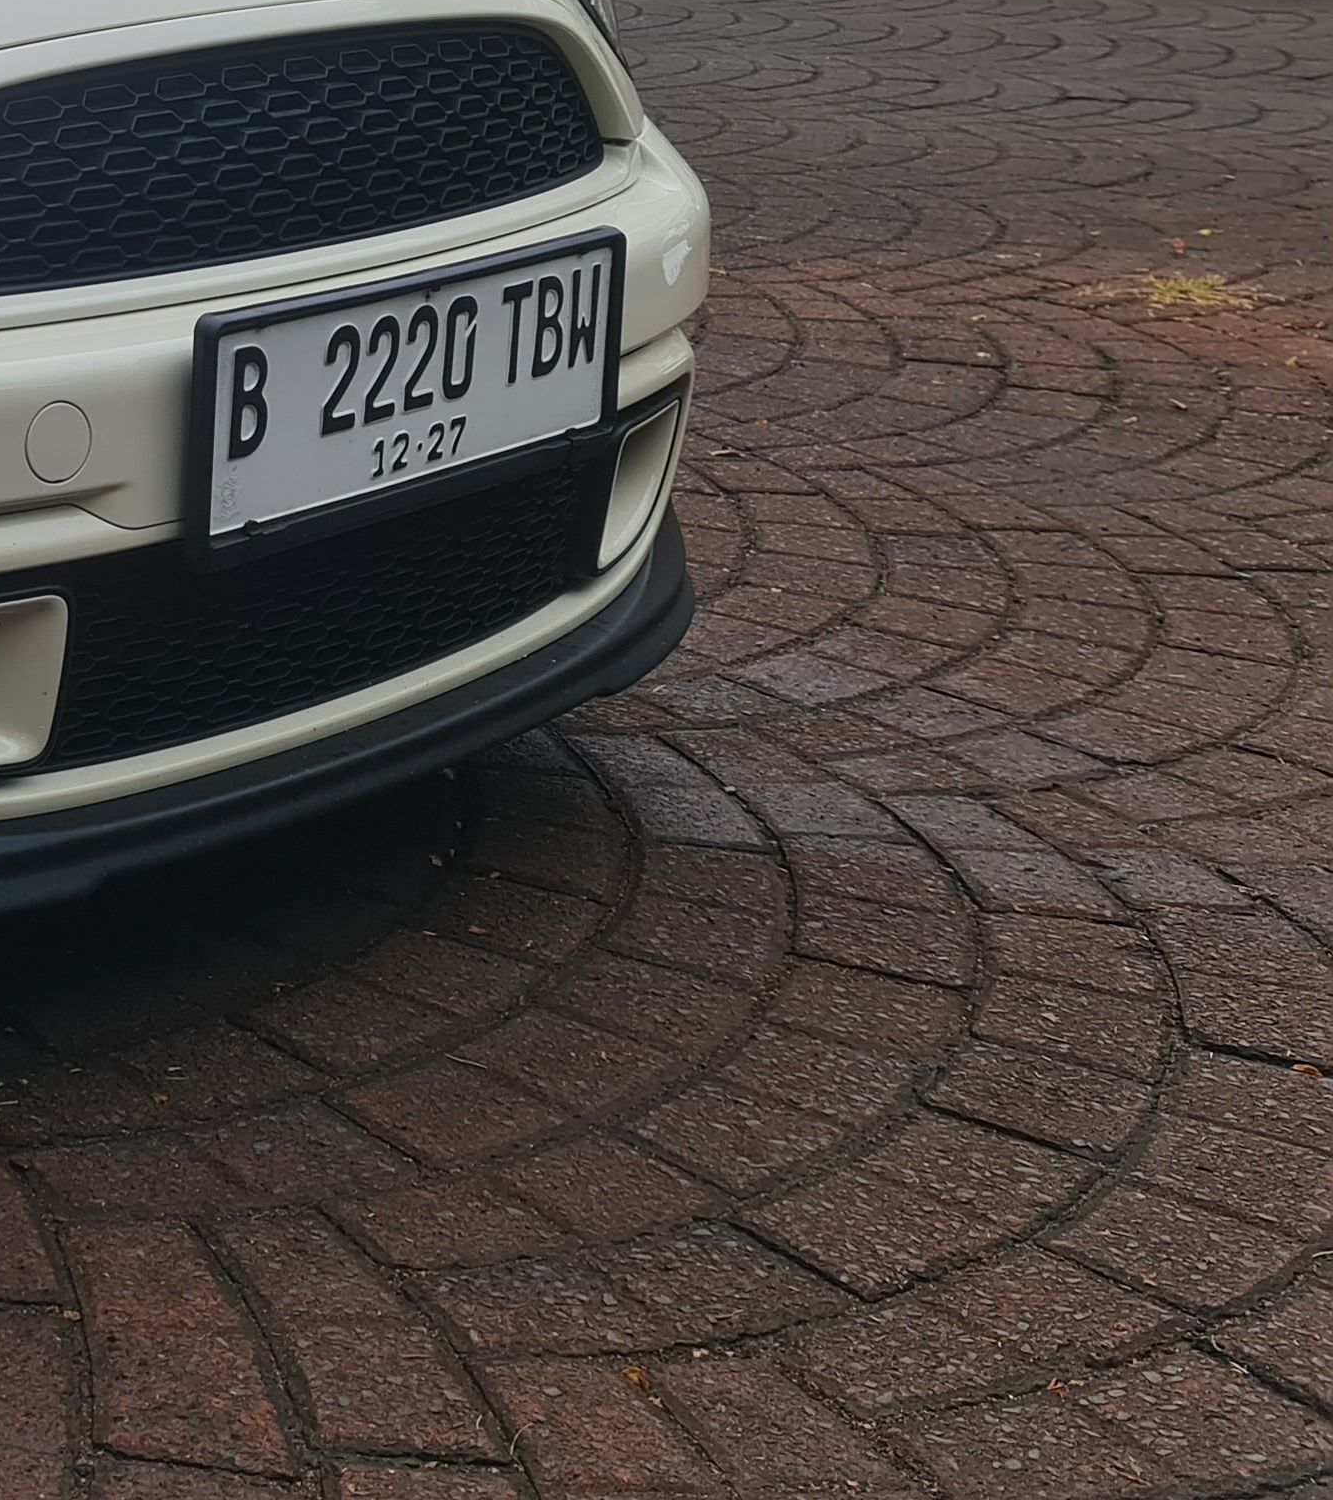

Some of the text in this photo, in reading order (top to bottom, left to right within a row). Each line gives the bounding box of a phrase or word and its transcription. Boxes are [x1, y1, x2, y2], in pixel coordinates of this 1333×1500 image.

[228, 263, 602, 460] B 2220 TBW
